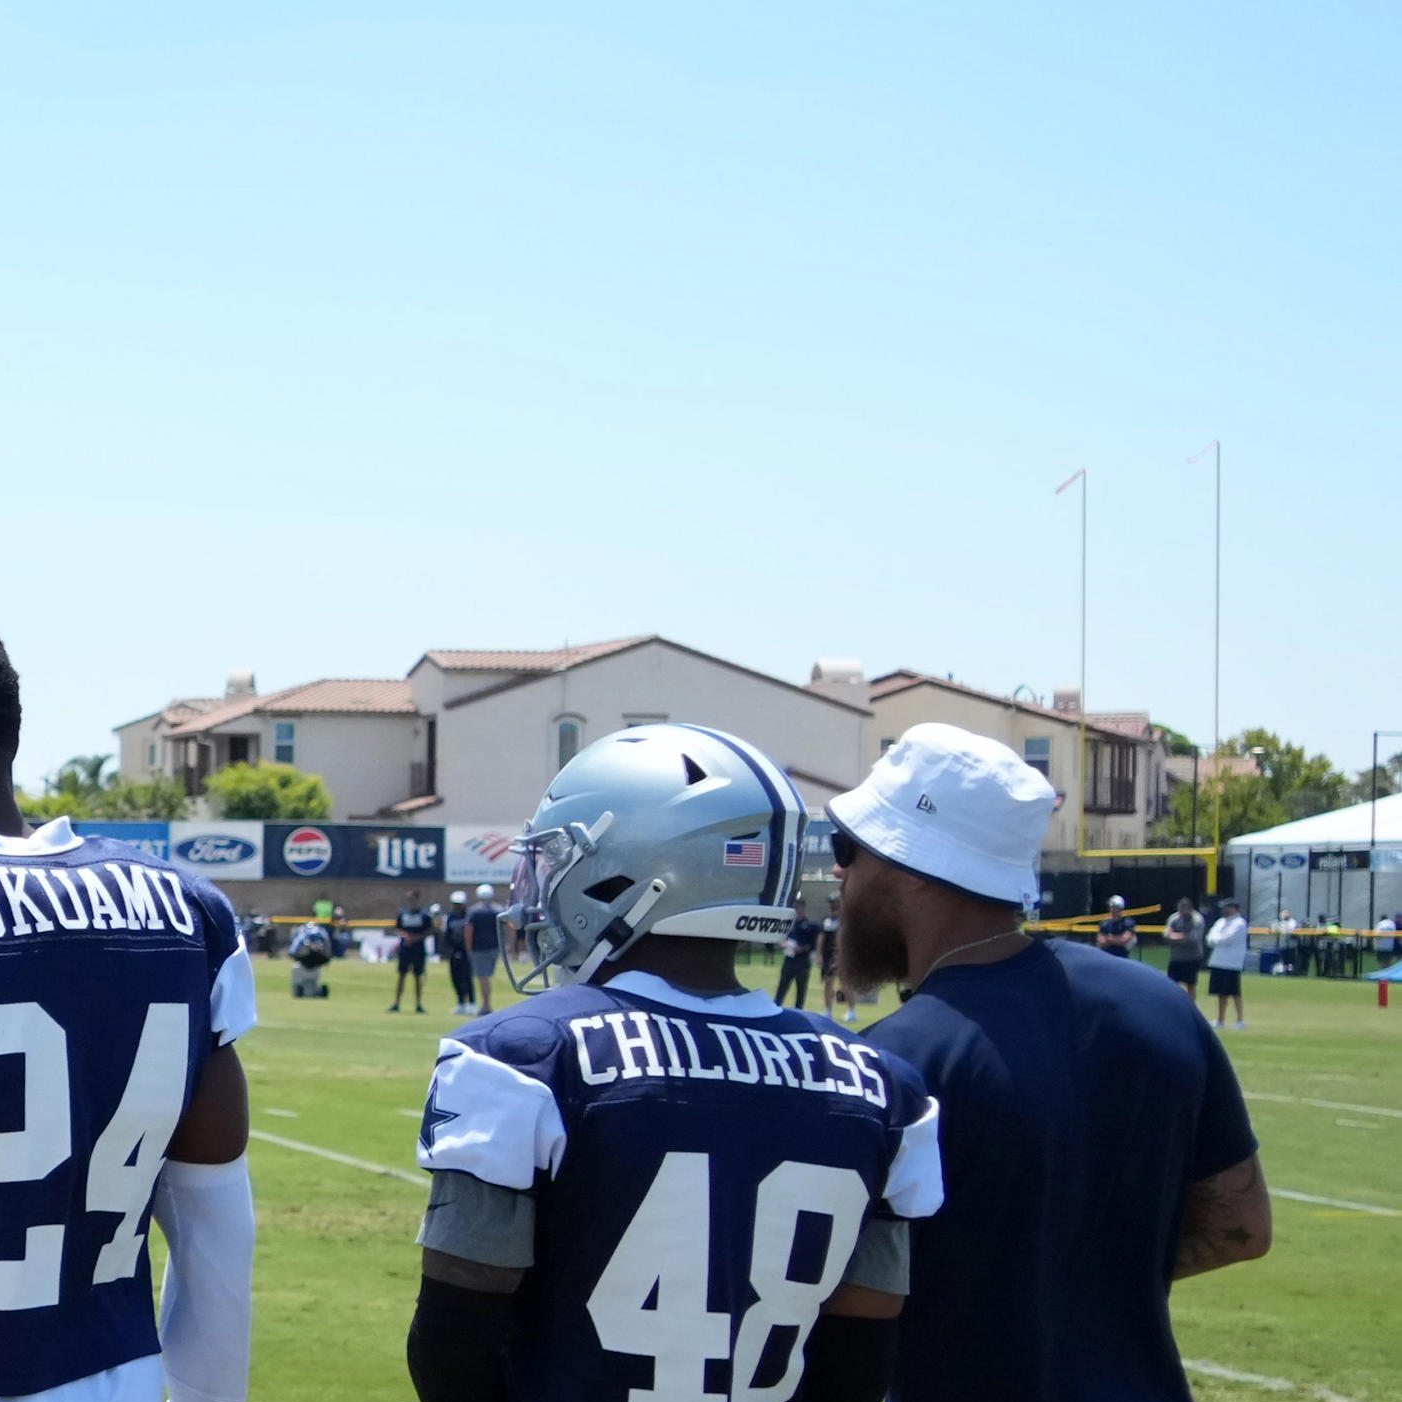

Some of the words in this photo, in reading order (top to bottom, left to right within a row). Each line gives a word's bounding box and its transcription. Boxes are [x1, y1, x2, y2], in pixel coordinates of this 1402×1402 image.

[187, 838, 243, 862] Ford
[376, 835, 437, 877] Lite
[569, 1012, 888, 1109] CHILDRESS
